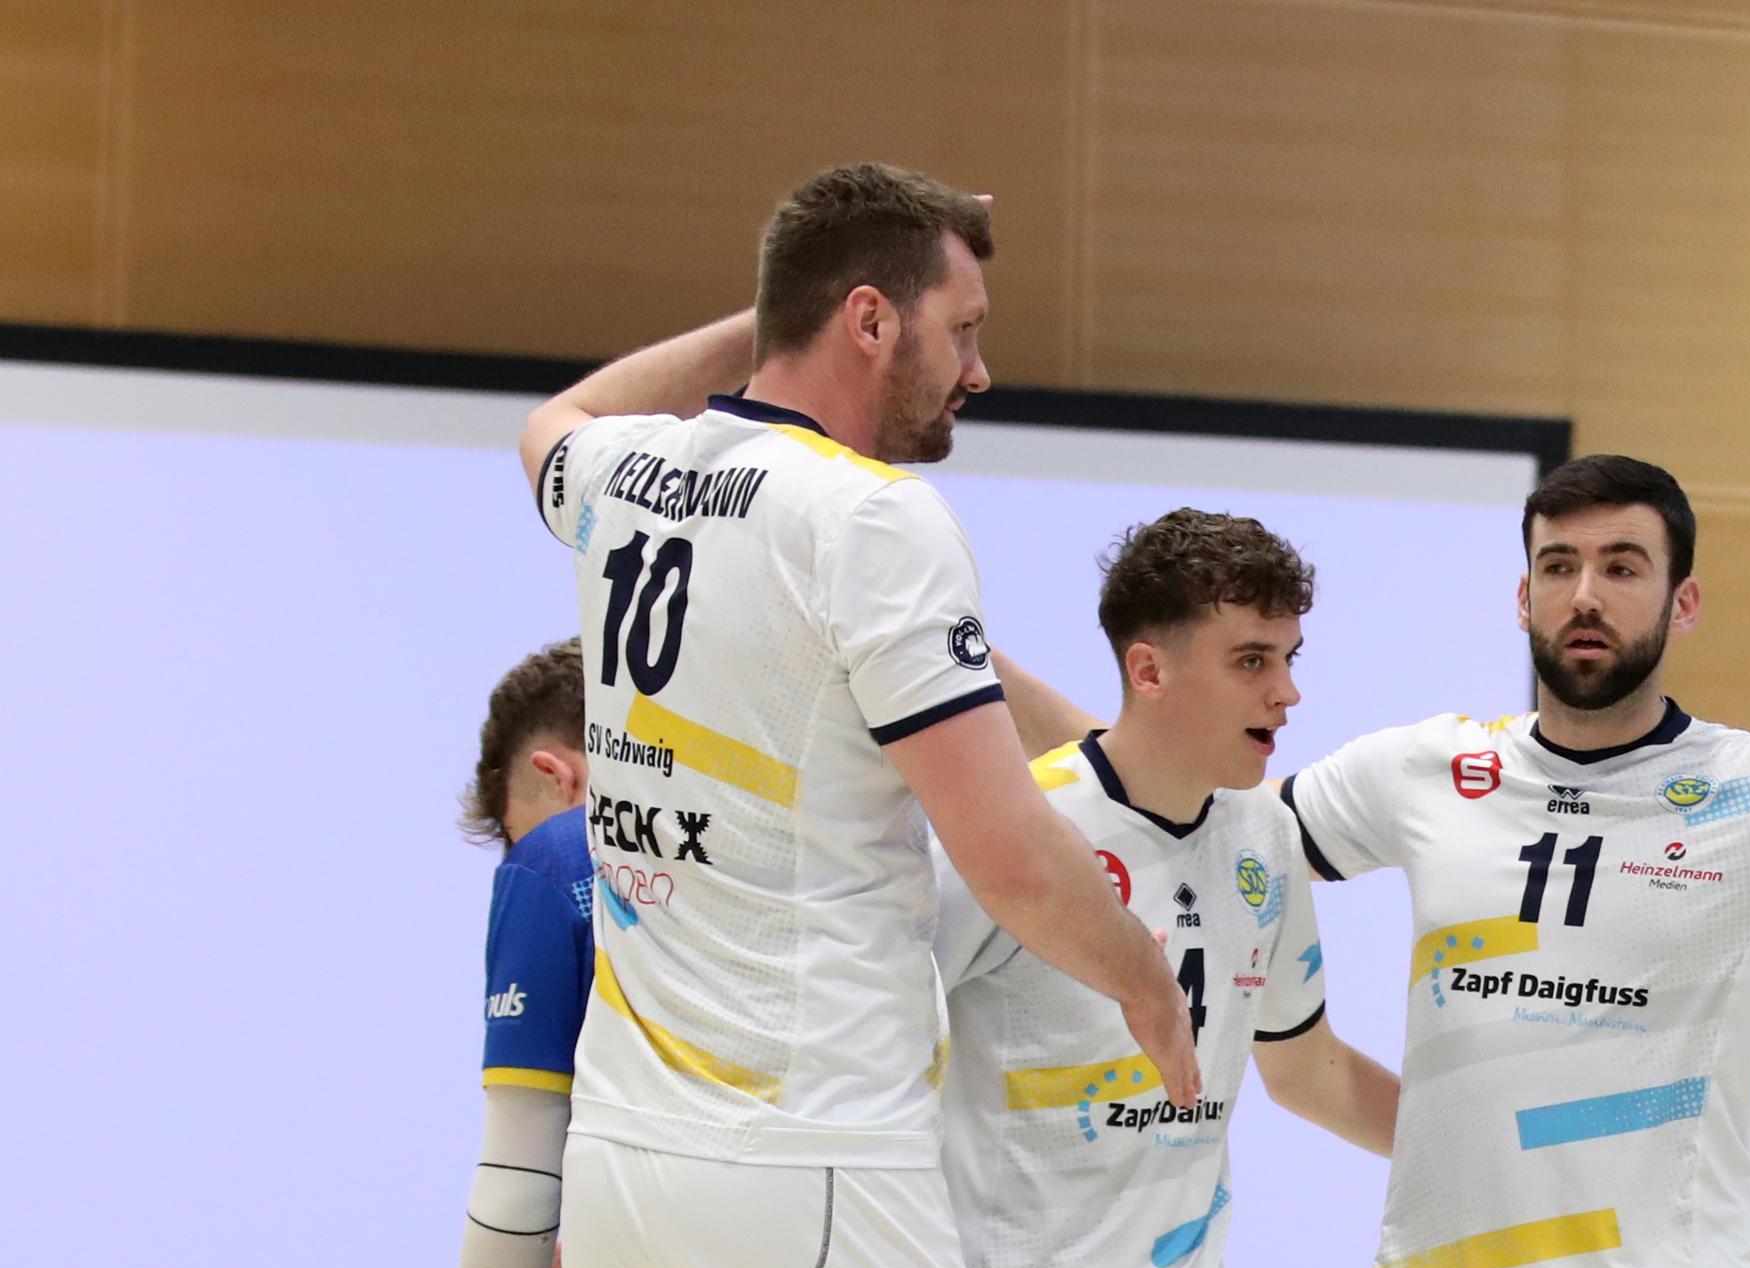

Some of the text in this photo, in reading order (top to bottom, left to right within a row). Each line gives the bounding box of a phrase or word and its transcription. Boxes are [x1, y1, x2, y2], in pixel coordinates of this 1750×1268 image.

[601, 529, 693, 696] 10
[588, 723, 674, 778] SV Schwaig
[1547, 799, 1590, 815] errea
[1518, 832, 1604, 926] 11
[1620, 861, 1723, 882] Heinzelmann
[1649, 879, 1688, 892] Medien
[1451, 967, 1649, 1007] Zapf Daigfuss
